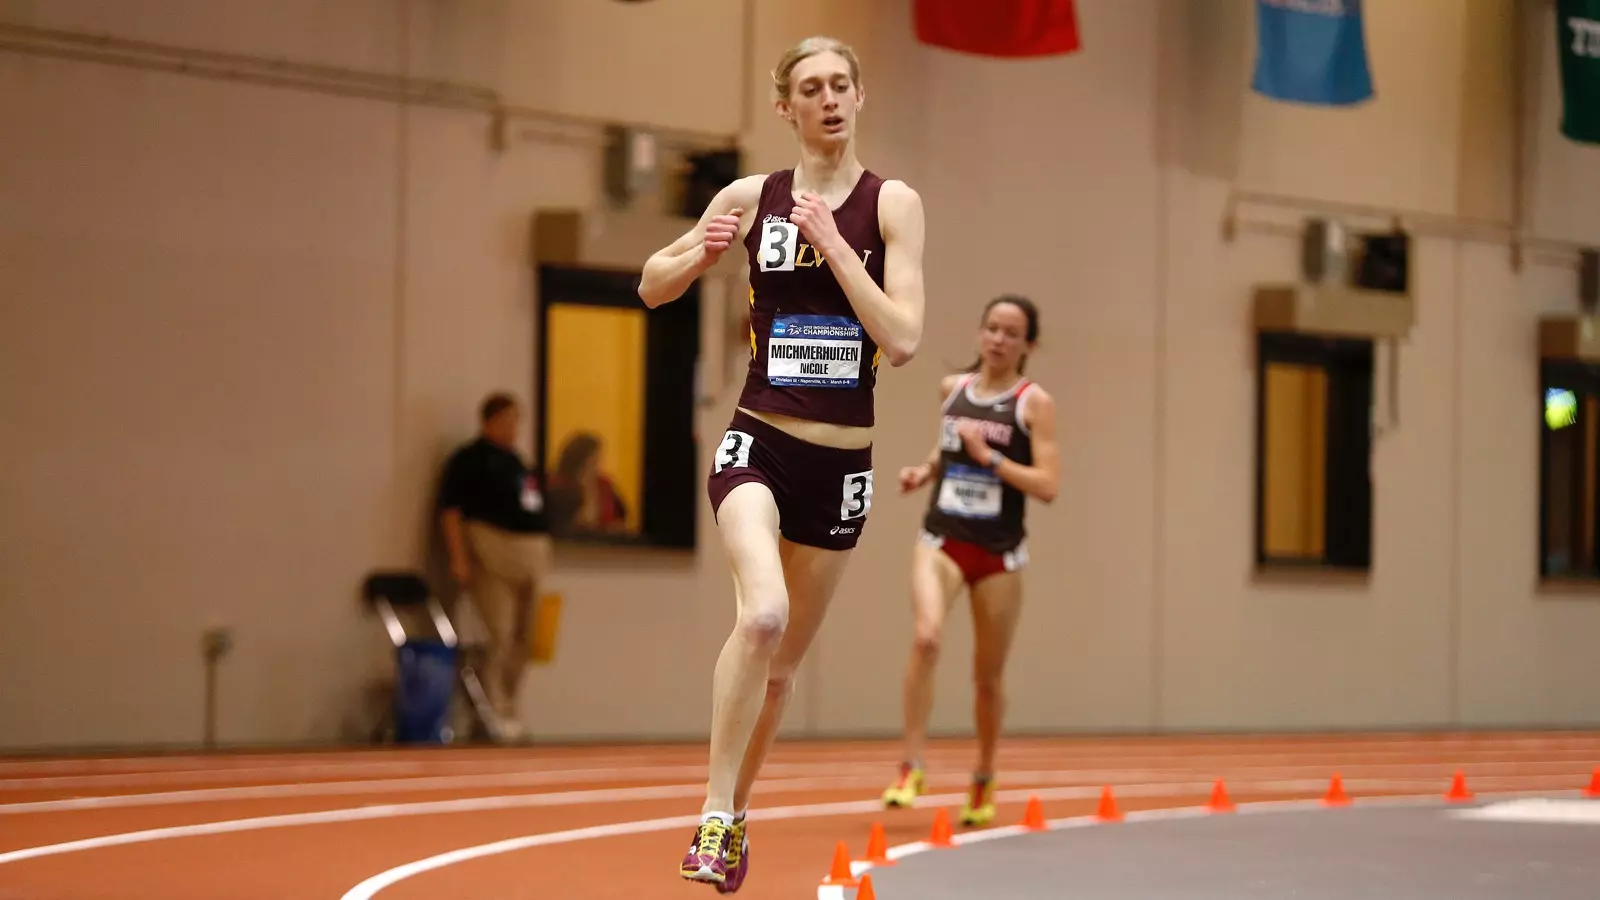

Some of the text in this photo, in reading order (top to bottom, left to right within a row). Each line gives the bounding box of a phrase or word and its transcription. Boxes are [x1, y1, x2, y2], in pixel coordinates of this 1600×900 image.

[766, 225, 789, 268] 3
[803, 329, 859, 337] CHAMPIONSHIPS
[771, 345, 859, 361] MICHMERHUIZEN
[800, 363, 829, 374] NICOLE
[720, 433, 742, 470] 3
[848, 475, 867, 517] 3
